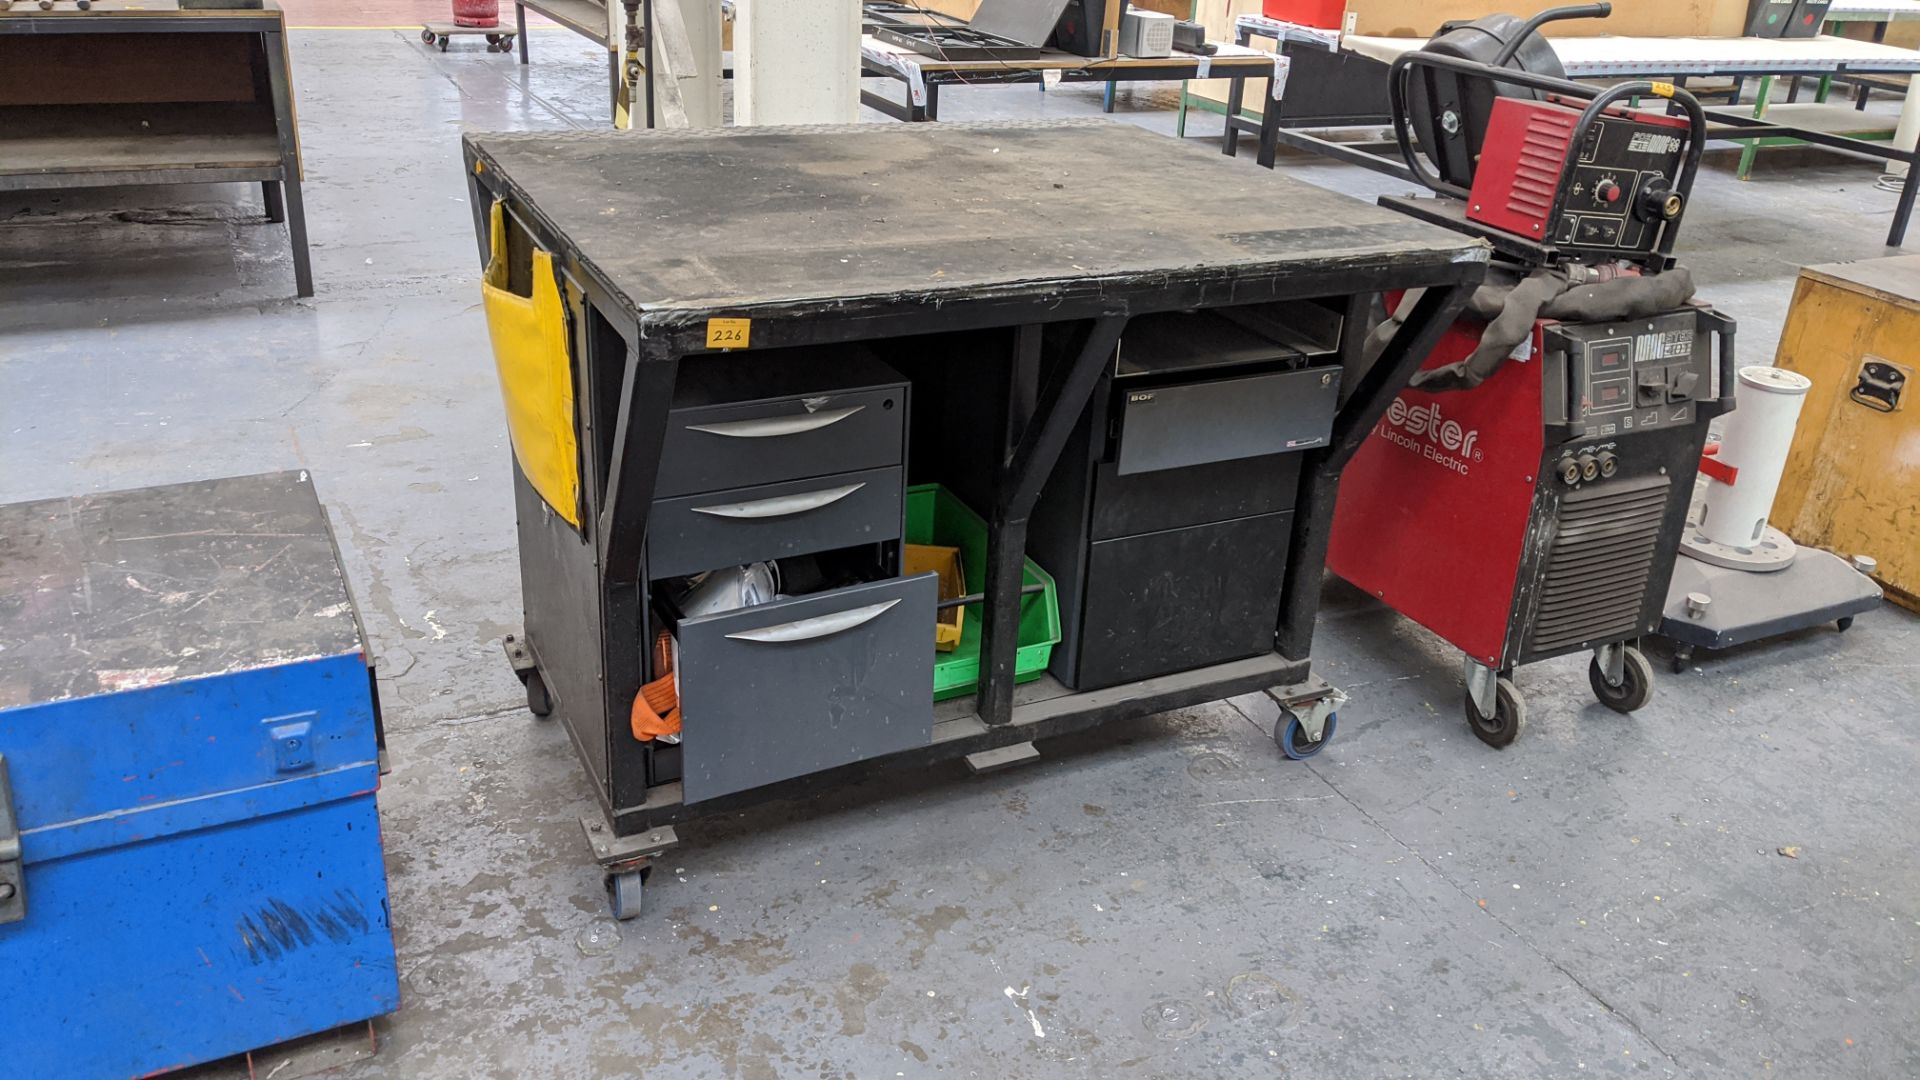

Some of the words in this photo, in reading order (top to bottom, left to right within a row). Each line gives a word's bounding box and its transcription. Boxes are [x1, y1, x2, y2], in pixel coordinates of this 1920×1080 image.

[713, 329, 741, 341] 226
[1380, 425, 1420, 454] Lincoln
[1424, 445, 1469, 475] Electric
[1387, 397, 1478, 458] ester
